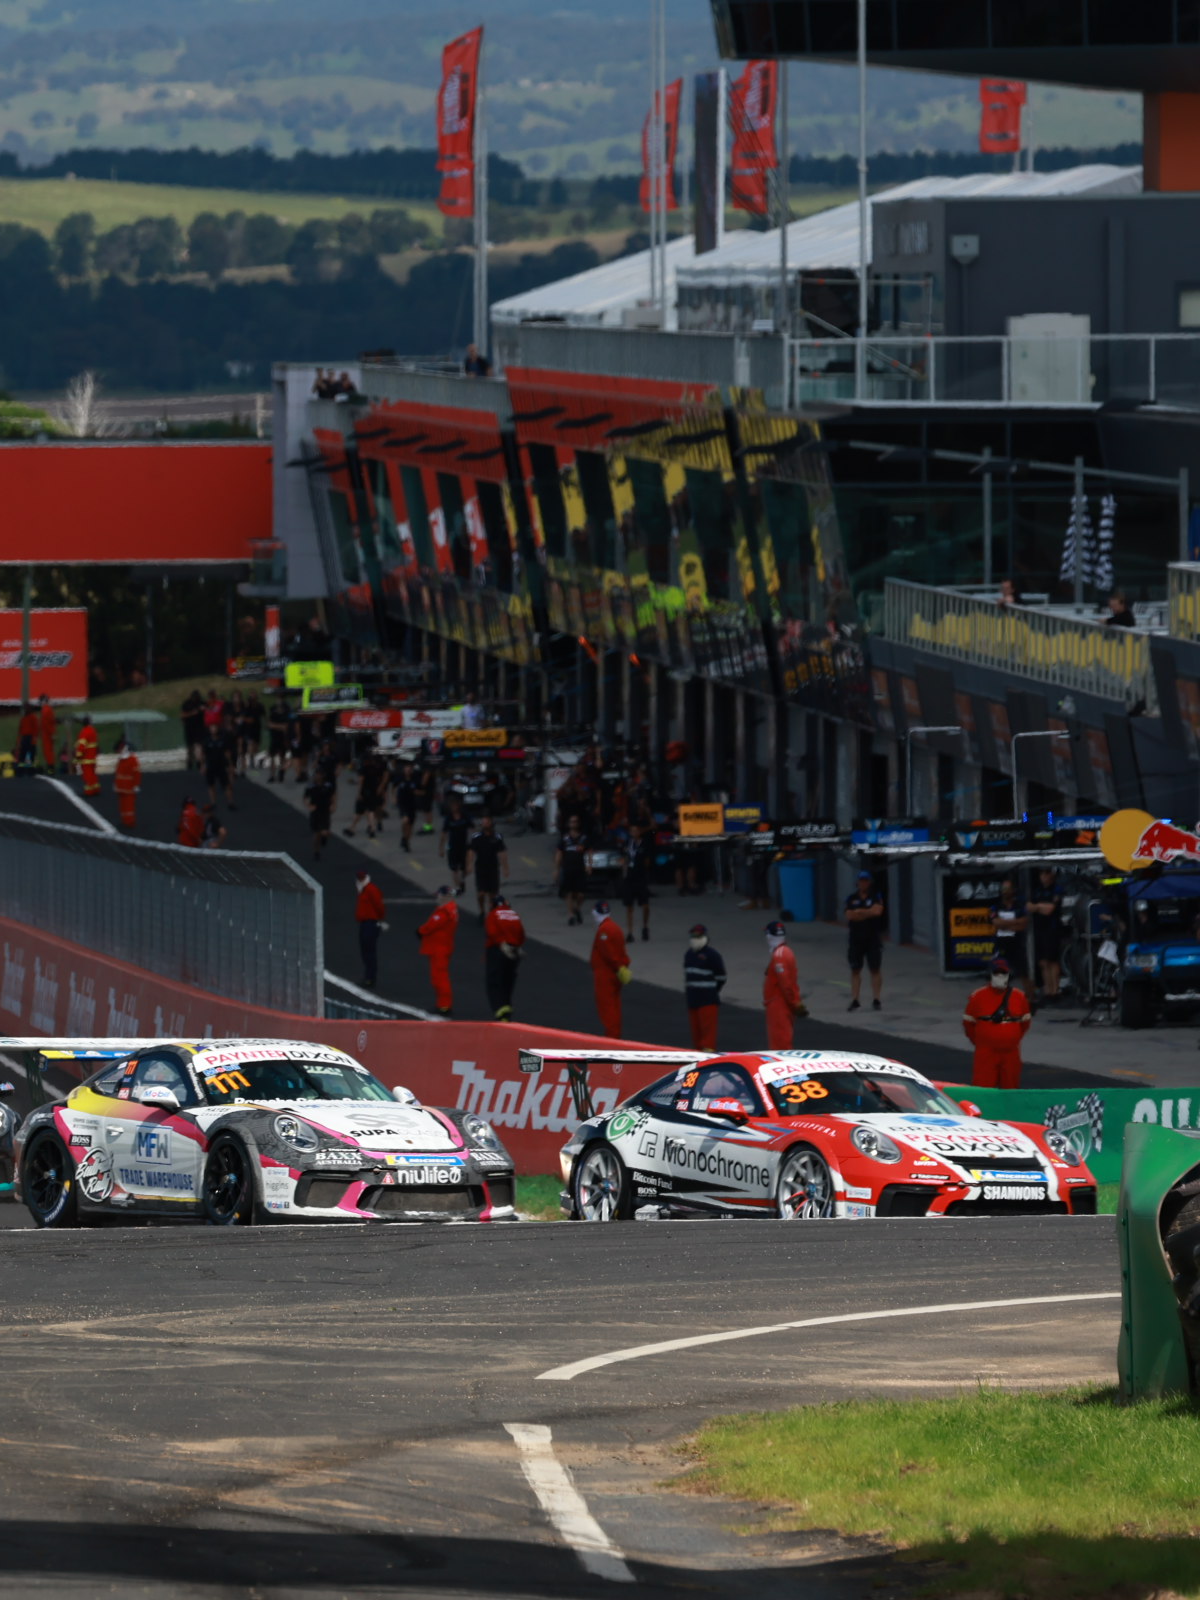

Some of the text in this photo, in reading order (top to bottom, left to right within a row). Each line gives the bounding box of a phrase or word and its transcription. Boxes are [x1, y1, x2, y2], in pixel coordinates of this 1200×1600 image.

[682, 1071, 700, 1089] 38
[143, 1088, 171, 1099] Mobil
[779, 1080, 829, 1104] 38
[71, 1135, 90, 1144] BOSS
[138, 1132, 169, 1160] MFW
[932, 1141, 1026, 1154] DIXON
[315, 1152, 362, 1160] BAXX
[471, 1152, 505, 1162] BAXX
[662, 1136, 770, 1188] Monochrome
[120, 1168, 144, 1186] TRADE
[146, 1170, 194, 1191] WAREHOUSE
[632, 1170, 673, 1190] Bitcoin Fund
[637, 1186, 658, 1195] BOSS
[983, 1185, 1046, 1201] SHANNONS
